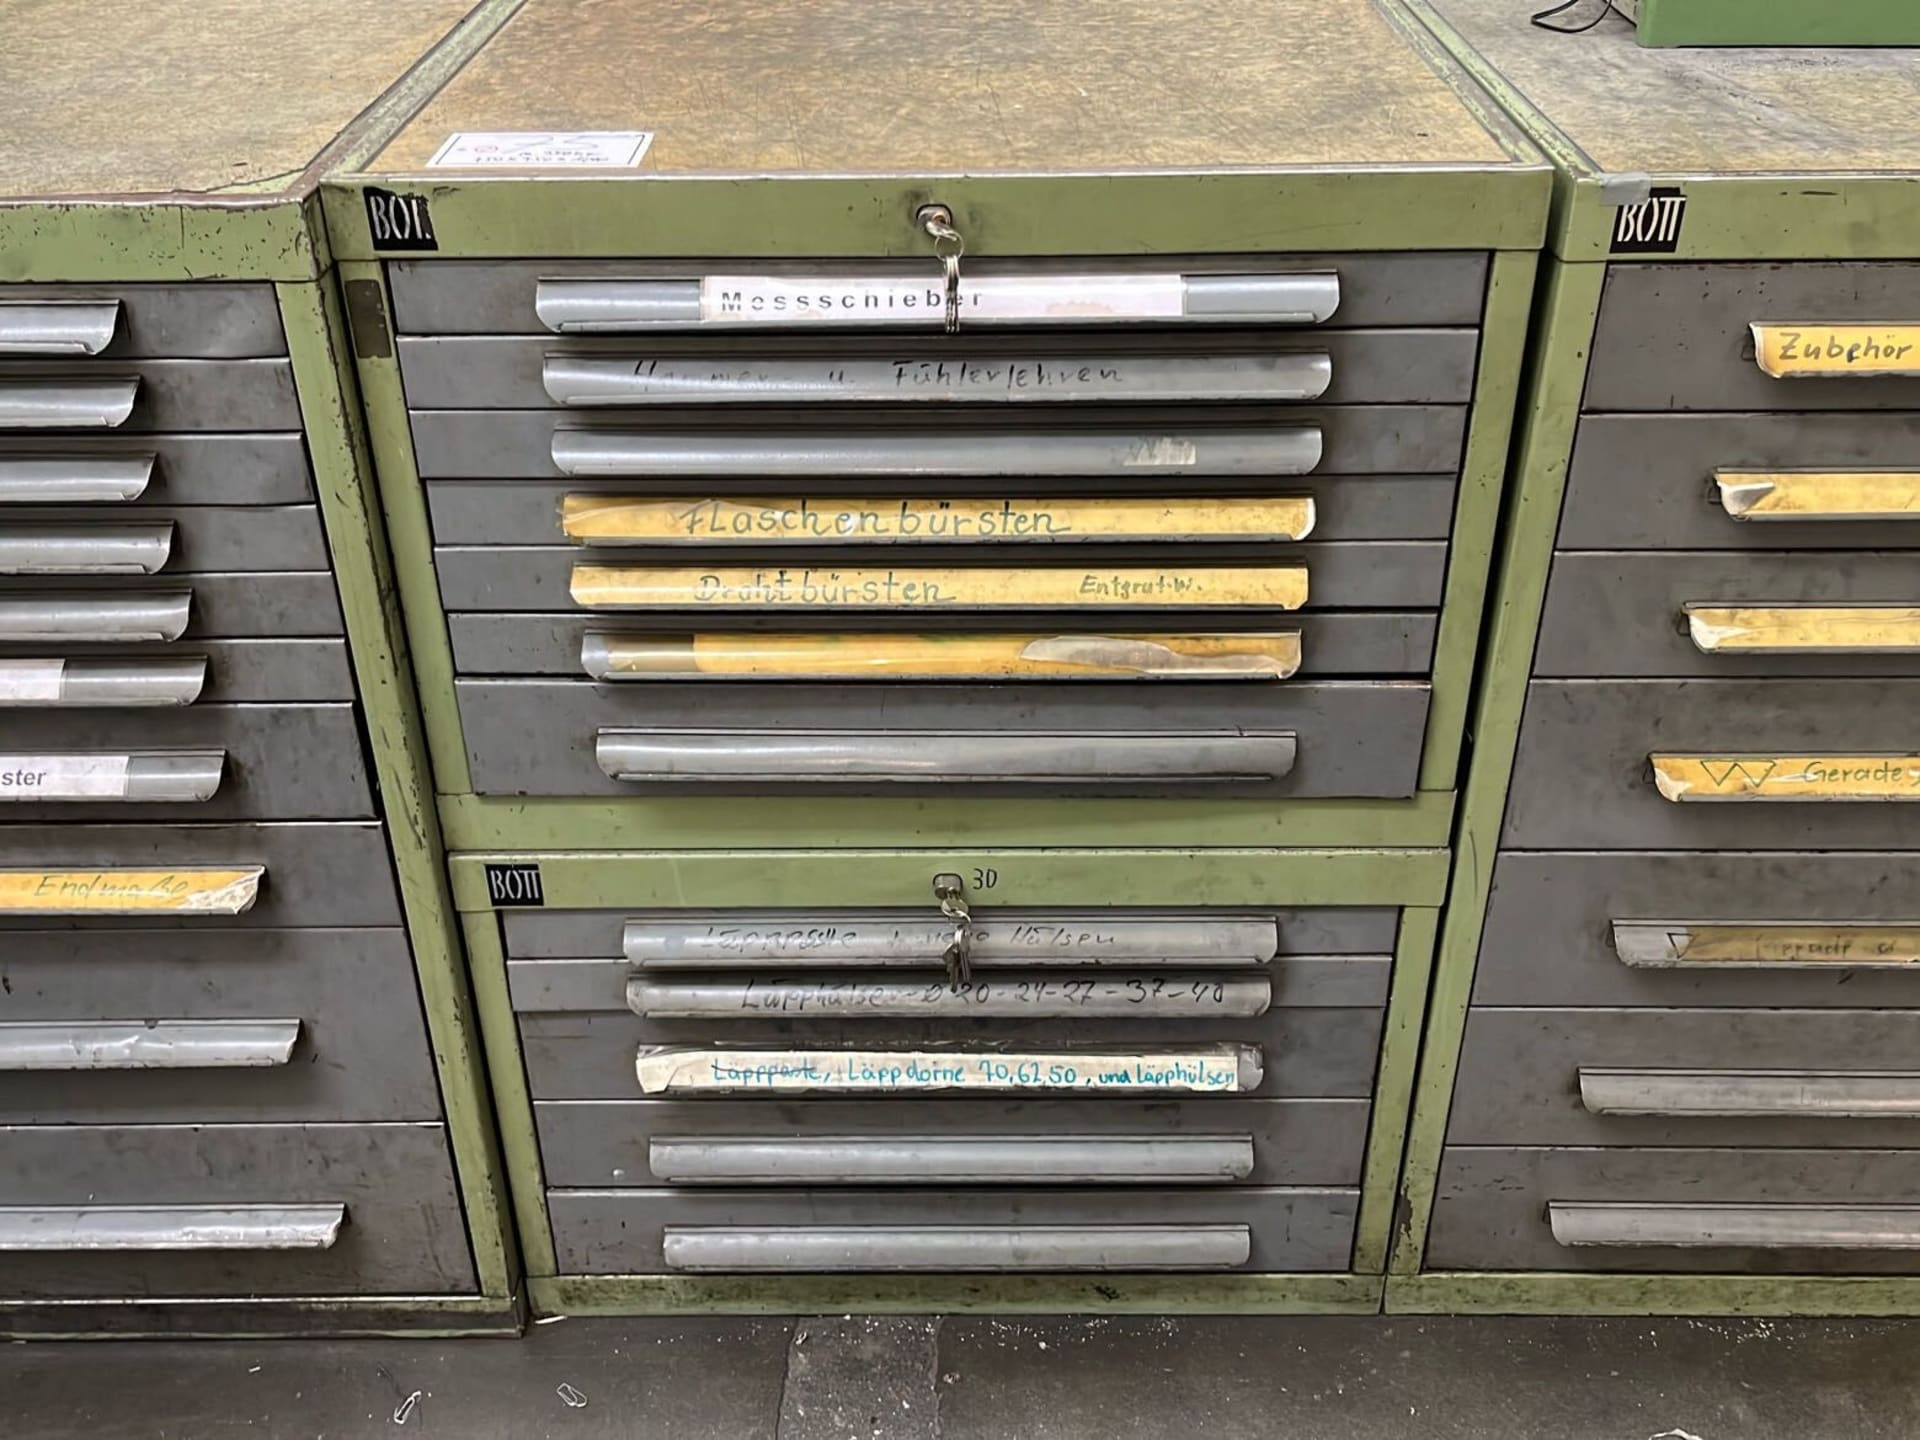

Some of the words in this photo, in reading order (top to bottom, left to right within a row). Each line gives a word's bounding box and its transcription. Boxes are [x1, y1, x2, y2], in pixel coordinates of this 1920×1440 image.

[1617, 196, 1687, 242] BOTT
[1778, 332, 1913, 363] Zubehör
[892, 359, 1123, 389] Fühlerlehren
[1, 769, 47, 786] ster
[1803, 761, 1903, 784] Gerade
[489, 870, 541, 899] BOTT
[1099, 1069, 1132, 1084] und
